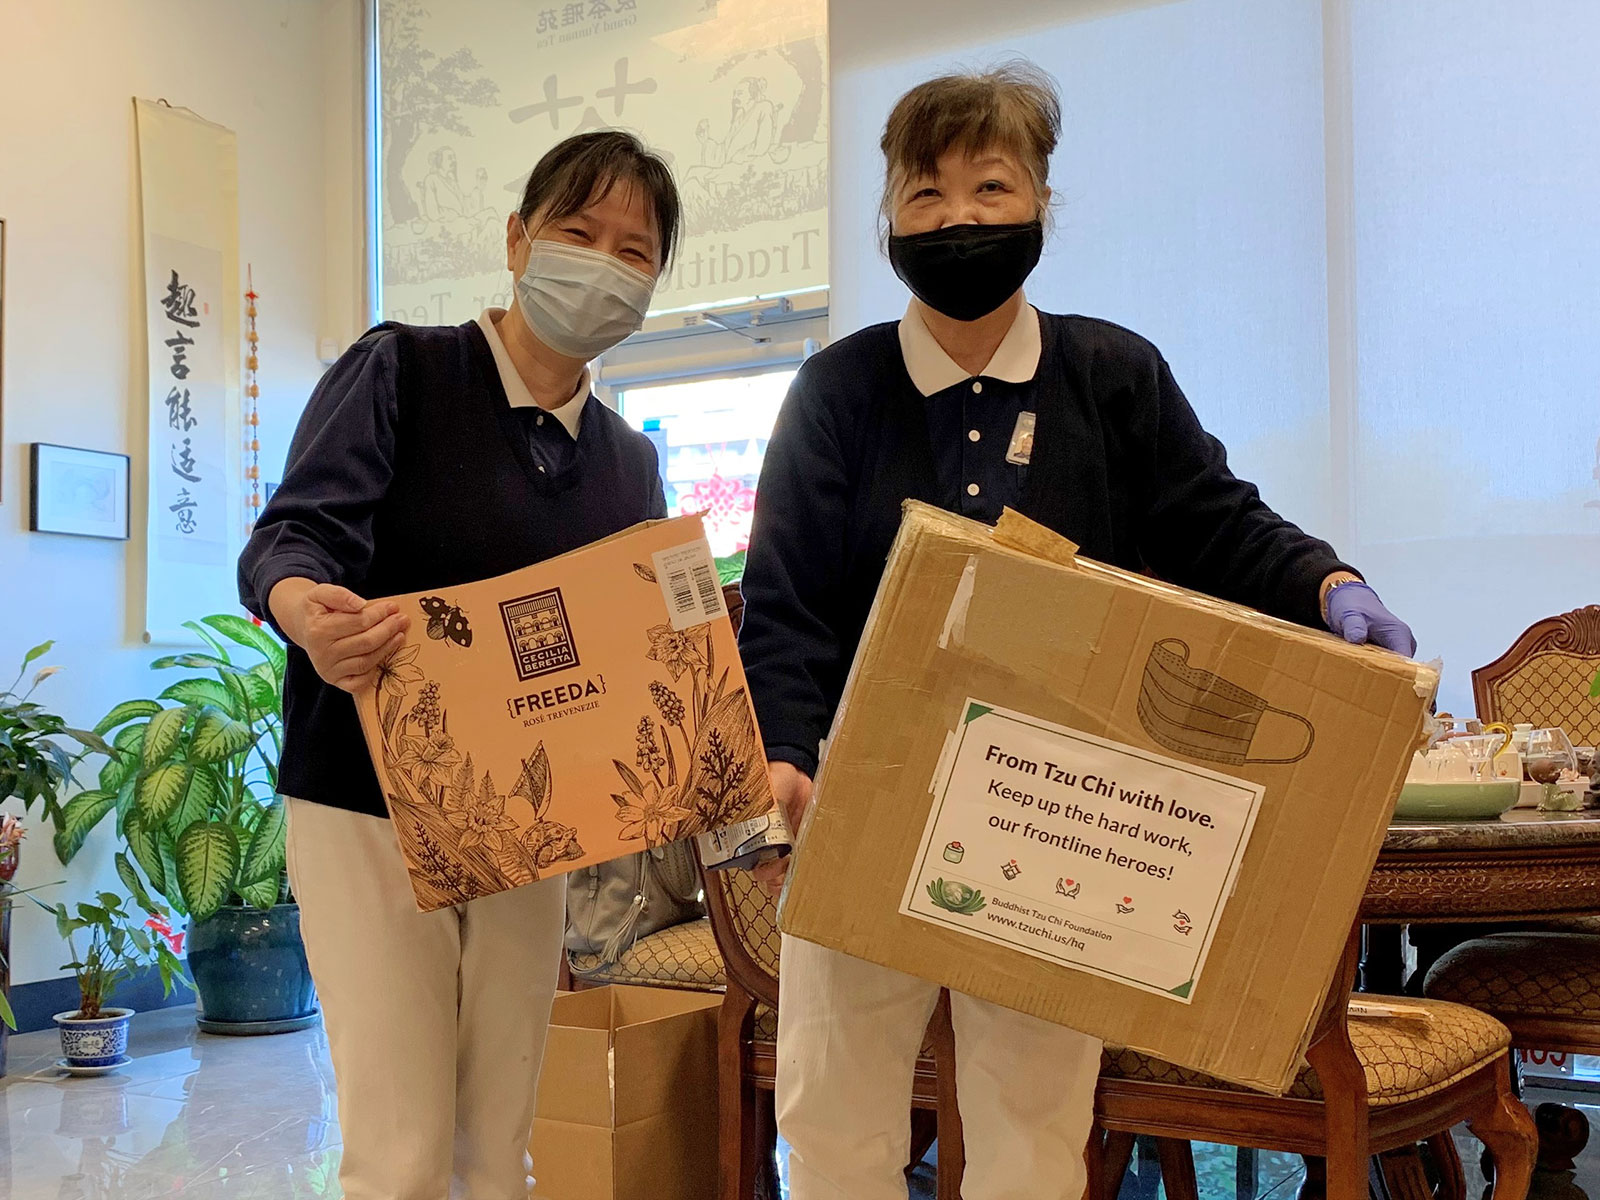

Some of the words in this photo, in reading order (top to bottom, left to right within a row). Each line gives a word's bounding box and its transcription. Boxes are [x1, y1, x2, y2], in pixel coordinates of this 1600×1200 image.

[522, 646, 569, 664] CECILIA
[524, 654, 571, 672] BERETTA
[523, 714, 546, 728] ROSÉ
[546, 700, 600, 722] TREVENEZIE
[985, 745, 1038, 775] From
[1043, 762, 1077, 786] Tzu
[1081, 774, 1115, 798] Chi
[1119, 786, 1164, 812] with
[1168, 799, 1216, 829] love.
[988, 779, 1034, 807] Keep
[1038, 799, 1060, 816] up
[1065, 803, 1094, 825] the
[1098, 813, 1140, 838] hard
[1144, 830, 1193, 857] work,
[988, 815, 1020, 832] our
[1023, 822, 1101, 860] frontline
[1106, 848, 1174, 881] heroes!
[987, 911, 1085, 951] www.tzuchi.us/hq
[992, 897, 1030, 916] Buddhist
[1032, 908, 1046, 921] Tzu
[1048, 913, 1063, 925] Chi
[1064, 919, 1112, 941] Foundation
